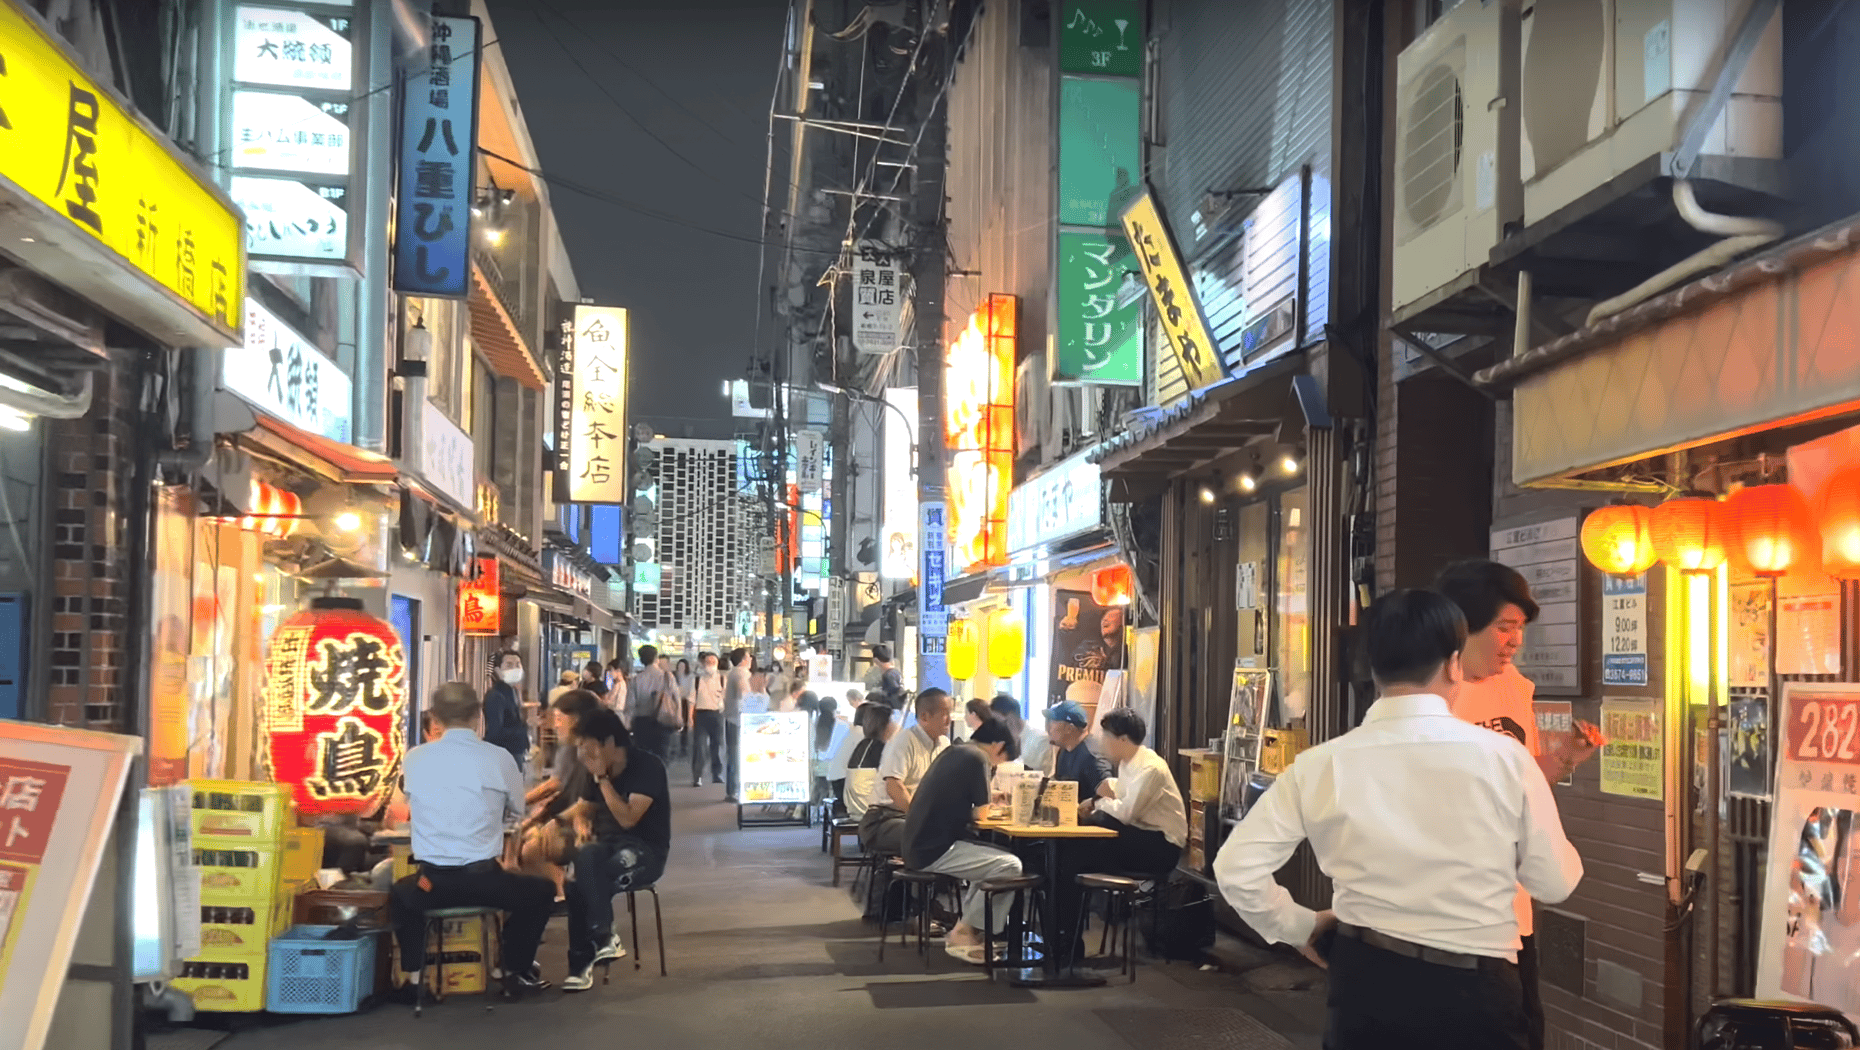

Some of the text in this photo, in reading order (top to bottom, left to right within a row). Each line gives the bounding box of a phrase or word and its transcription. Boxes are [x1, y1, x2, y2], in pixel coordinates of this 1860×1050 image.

[1091, 51, 1111, 67] 3F
[414, 117, 459, 284] 八重びし
[1081, 242, 1116, 371] マンダリン
[308, 636, 391, 798] 焼鳥
[0, 775, 47, 812] 店
